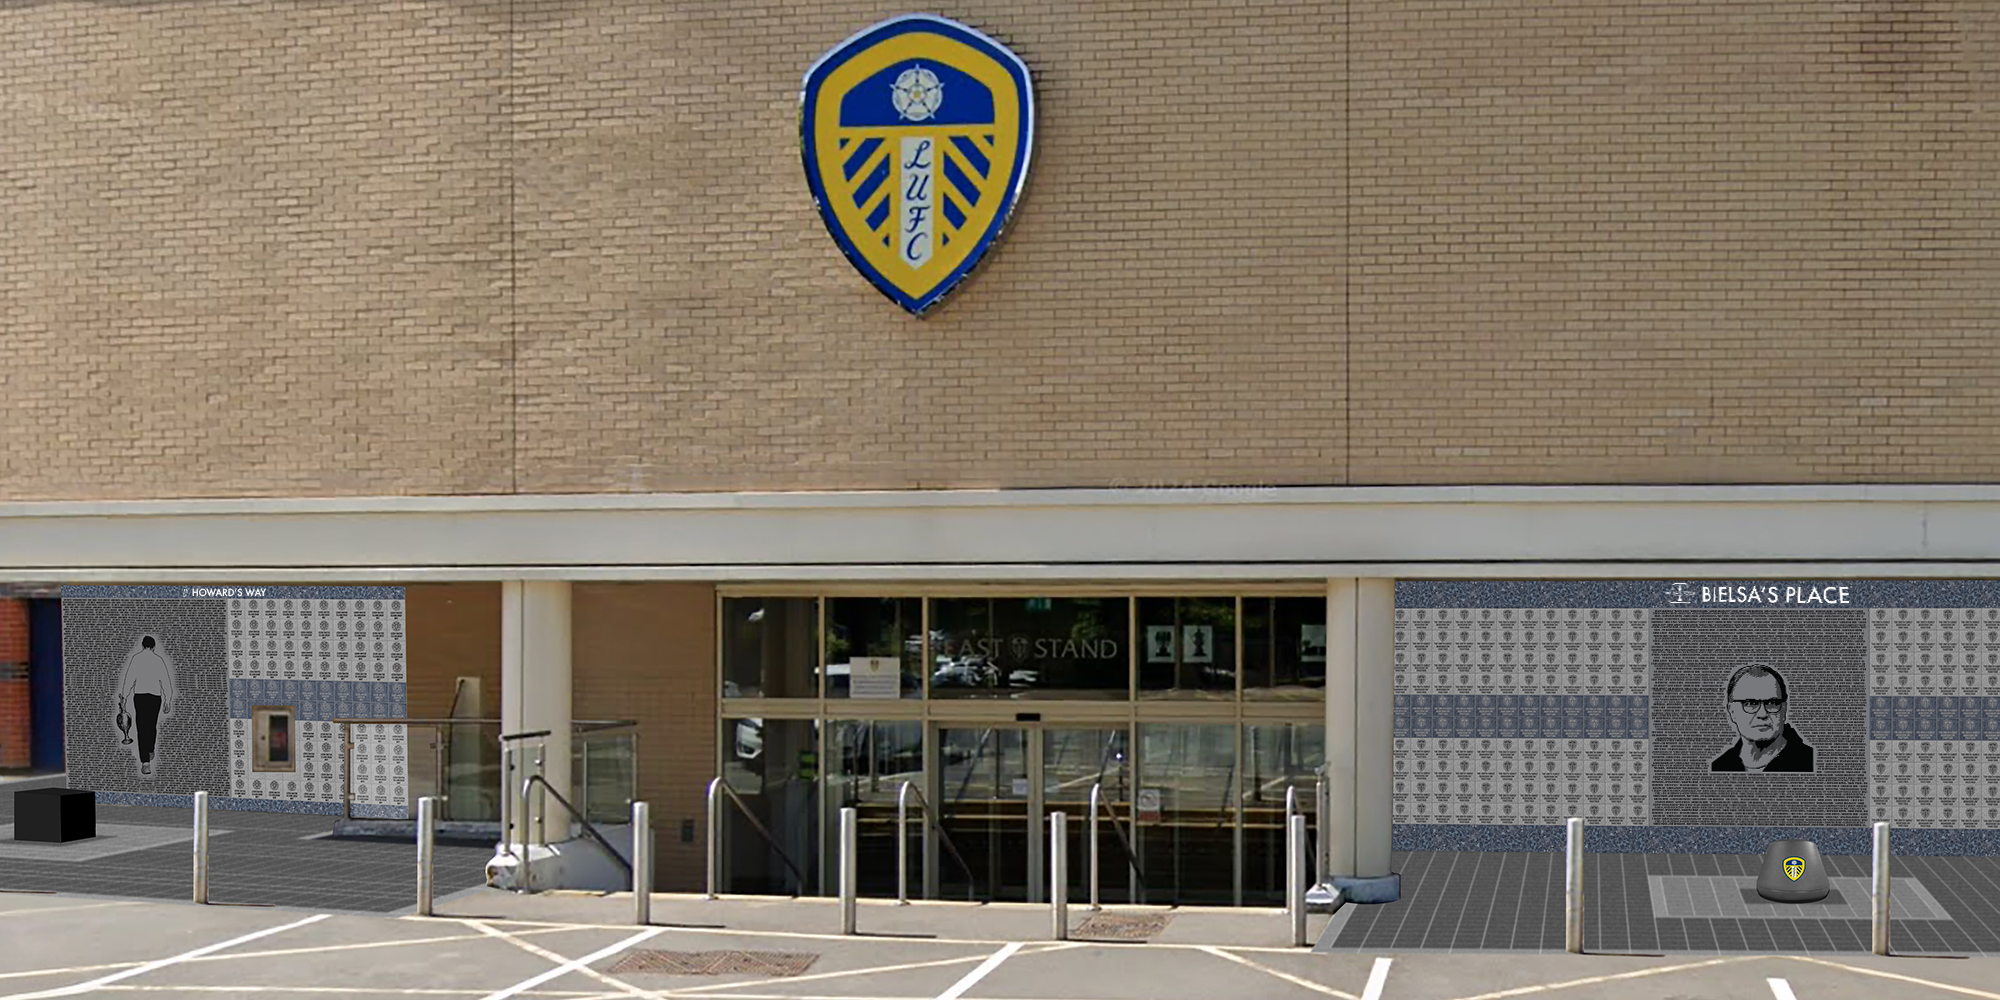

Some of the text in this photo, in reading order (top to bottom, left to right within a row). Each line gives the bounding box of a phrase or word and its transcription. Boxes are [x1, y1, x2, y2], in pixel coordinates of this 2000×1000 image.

[903, 139, 932, 262] LUFC
[192, 588, 267, 597] HOWARD'S WAY
[1702, 585, 1850, 604] BIELSA'S PLACE
[943, 638, 1118, 659] EAST STAND
